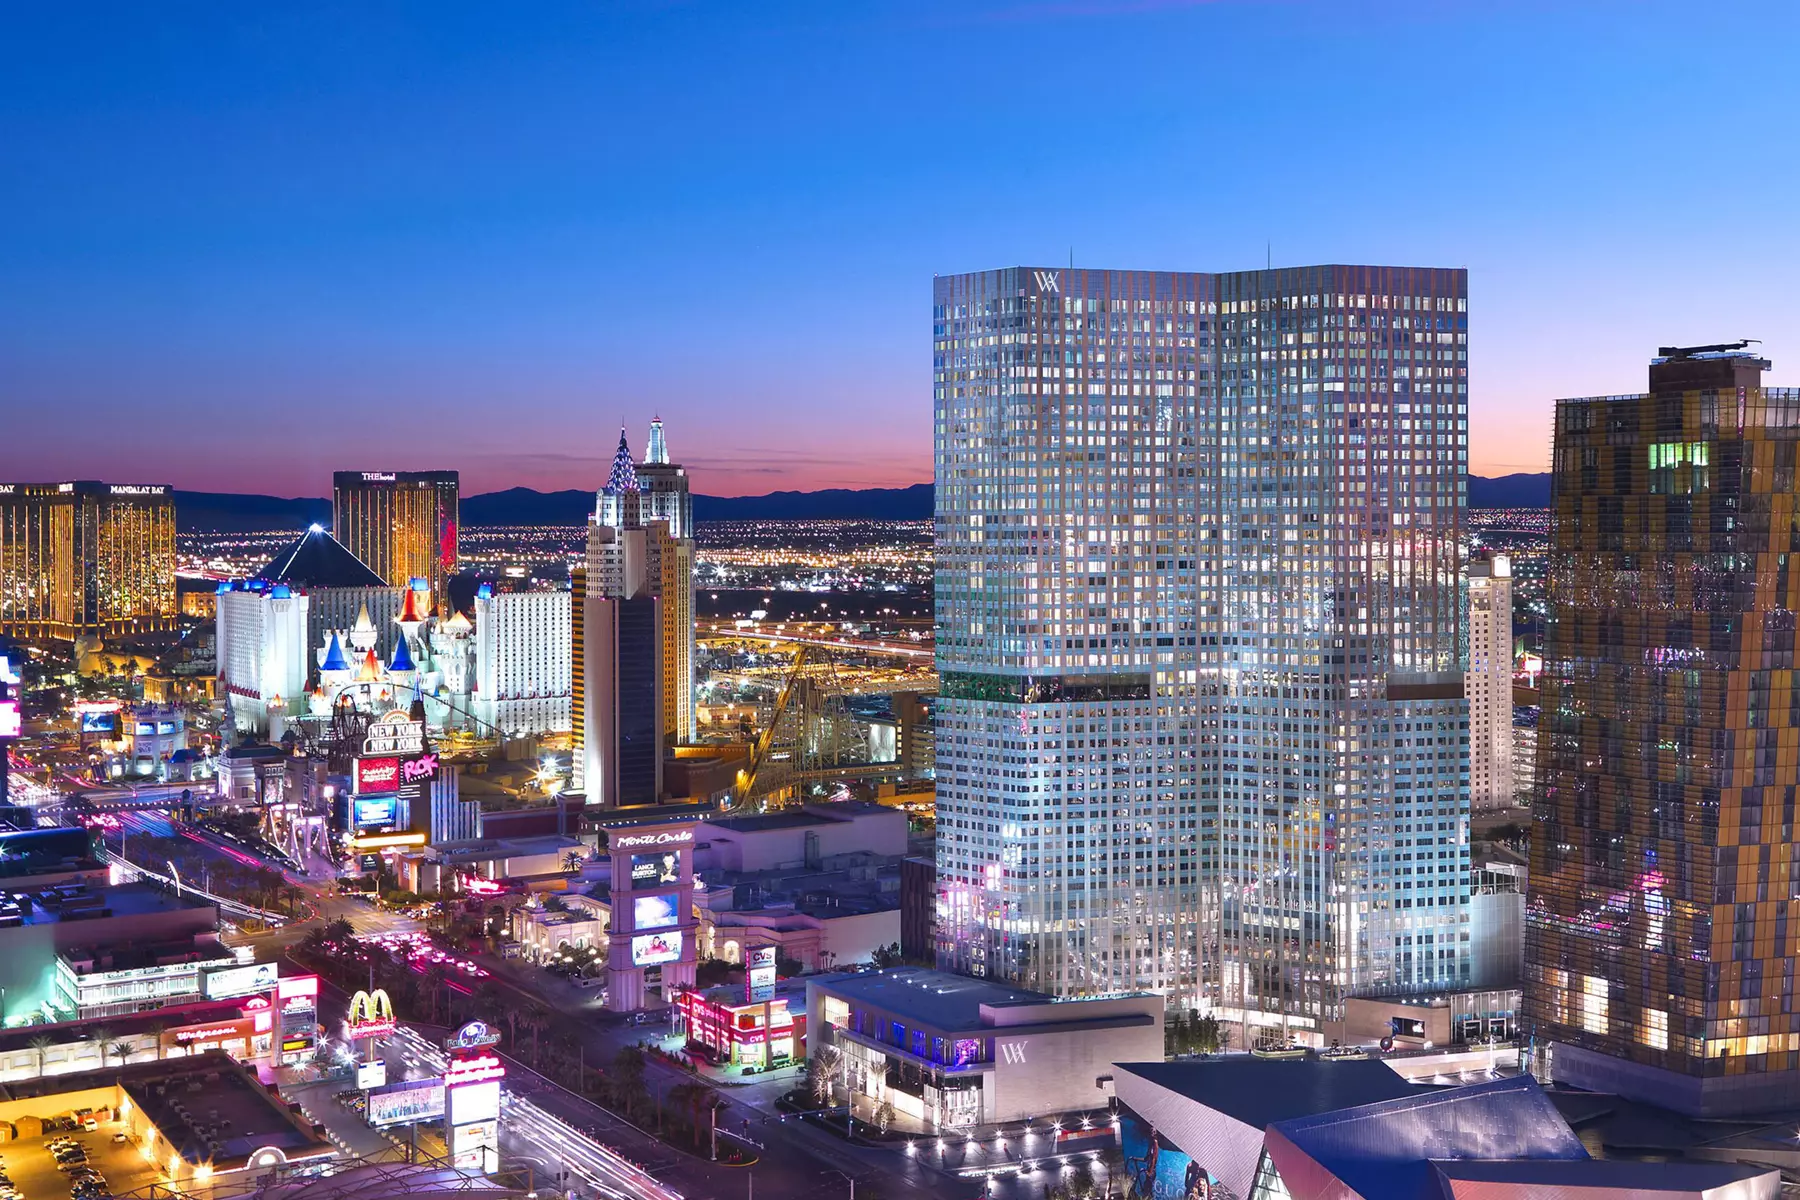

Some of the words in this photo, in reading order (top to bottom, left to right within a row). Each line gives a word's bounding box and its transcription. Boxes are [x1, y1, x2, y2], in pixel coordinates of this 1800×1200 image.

[110, 485, 150, 495] MANDALAY
[371, 725, 394, 738] NEW
[396, 723, 423, 736] YORK
[371, 740, 394, 752] NEW
[396, 738, 423, 750] YORK
[617, 834, 656, 848] Monte
[656, 831, 693, 844] Carlo
[753, 952, 772, 961] CVS
[693, 1002, 705, 1016] CVS
[176, 1026, 237, 1040] Walgreens
[749, 1034, 765, 1043] CVS
